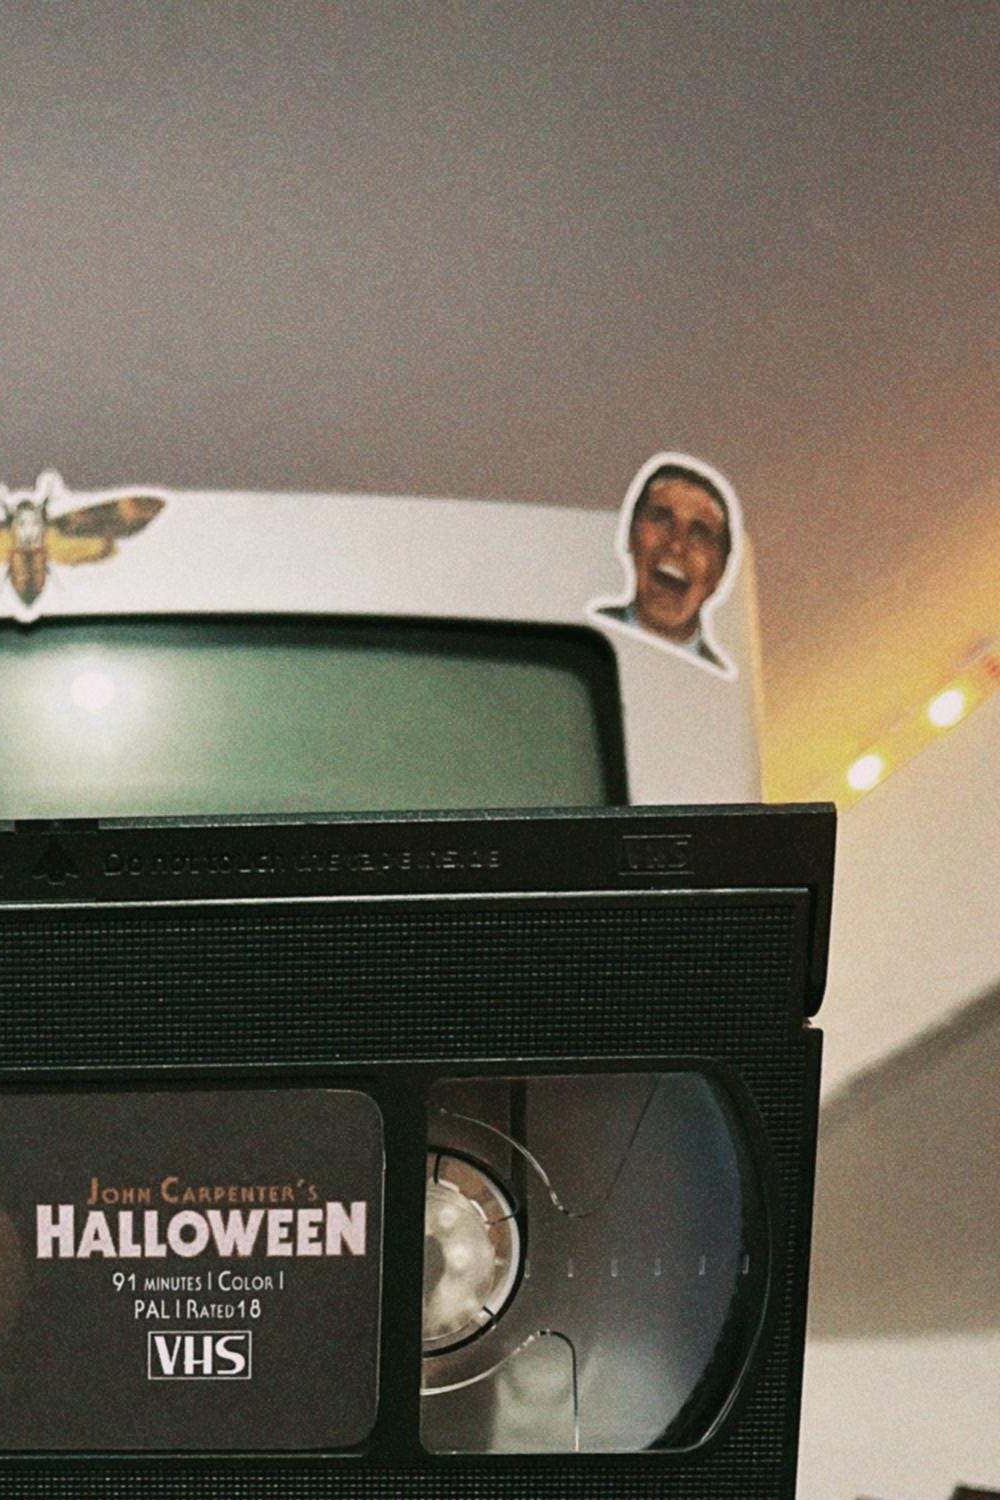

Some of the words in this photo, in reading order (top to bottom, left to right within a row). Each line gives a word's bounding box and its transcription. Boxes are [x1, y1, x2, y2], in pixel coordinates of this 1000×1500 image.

[103, 852, 143, 877] Do
[35, 1200, 369, 1261] HALLOWEEN
[111, 1271, 138, 1294] 91
[133, 1300, 172, 1321] PAL
[152, 1333, 247, 1377] VHS
